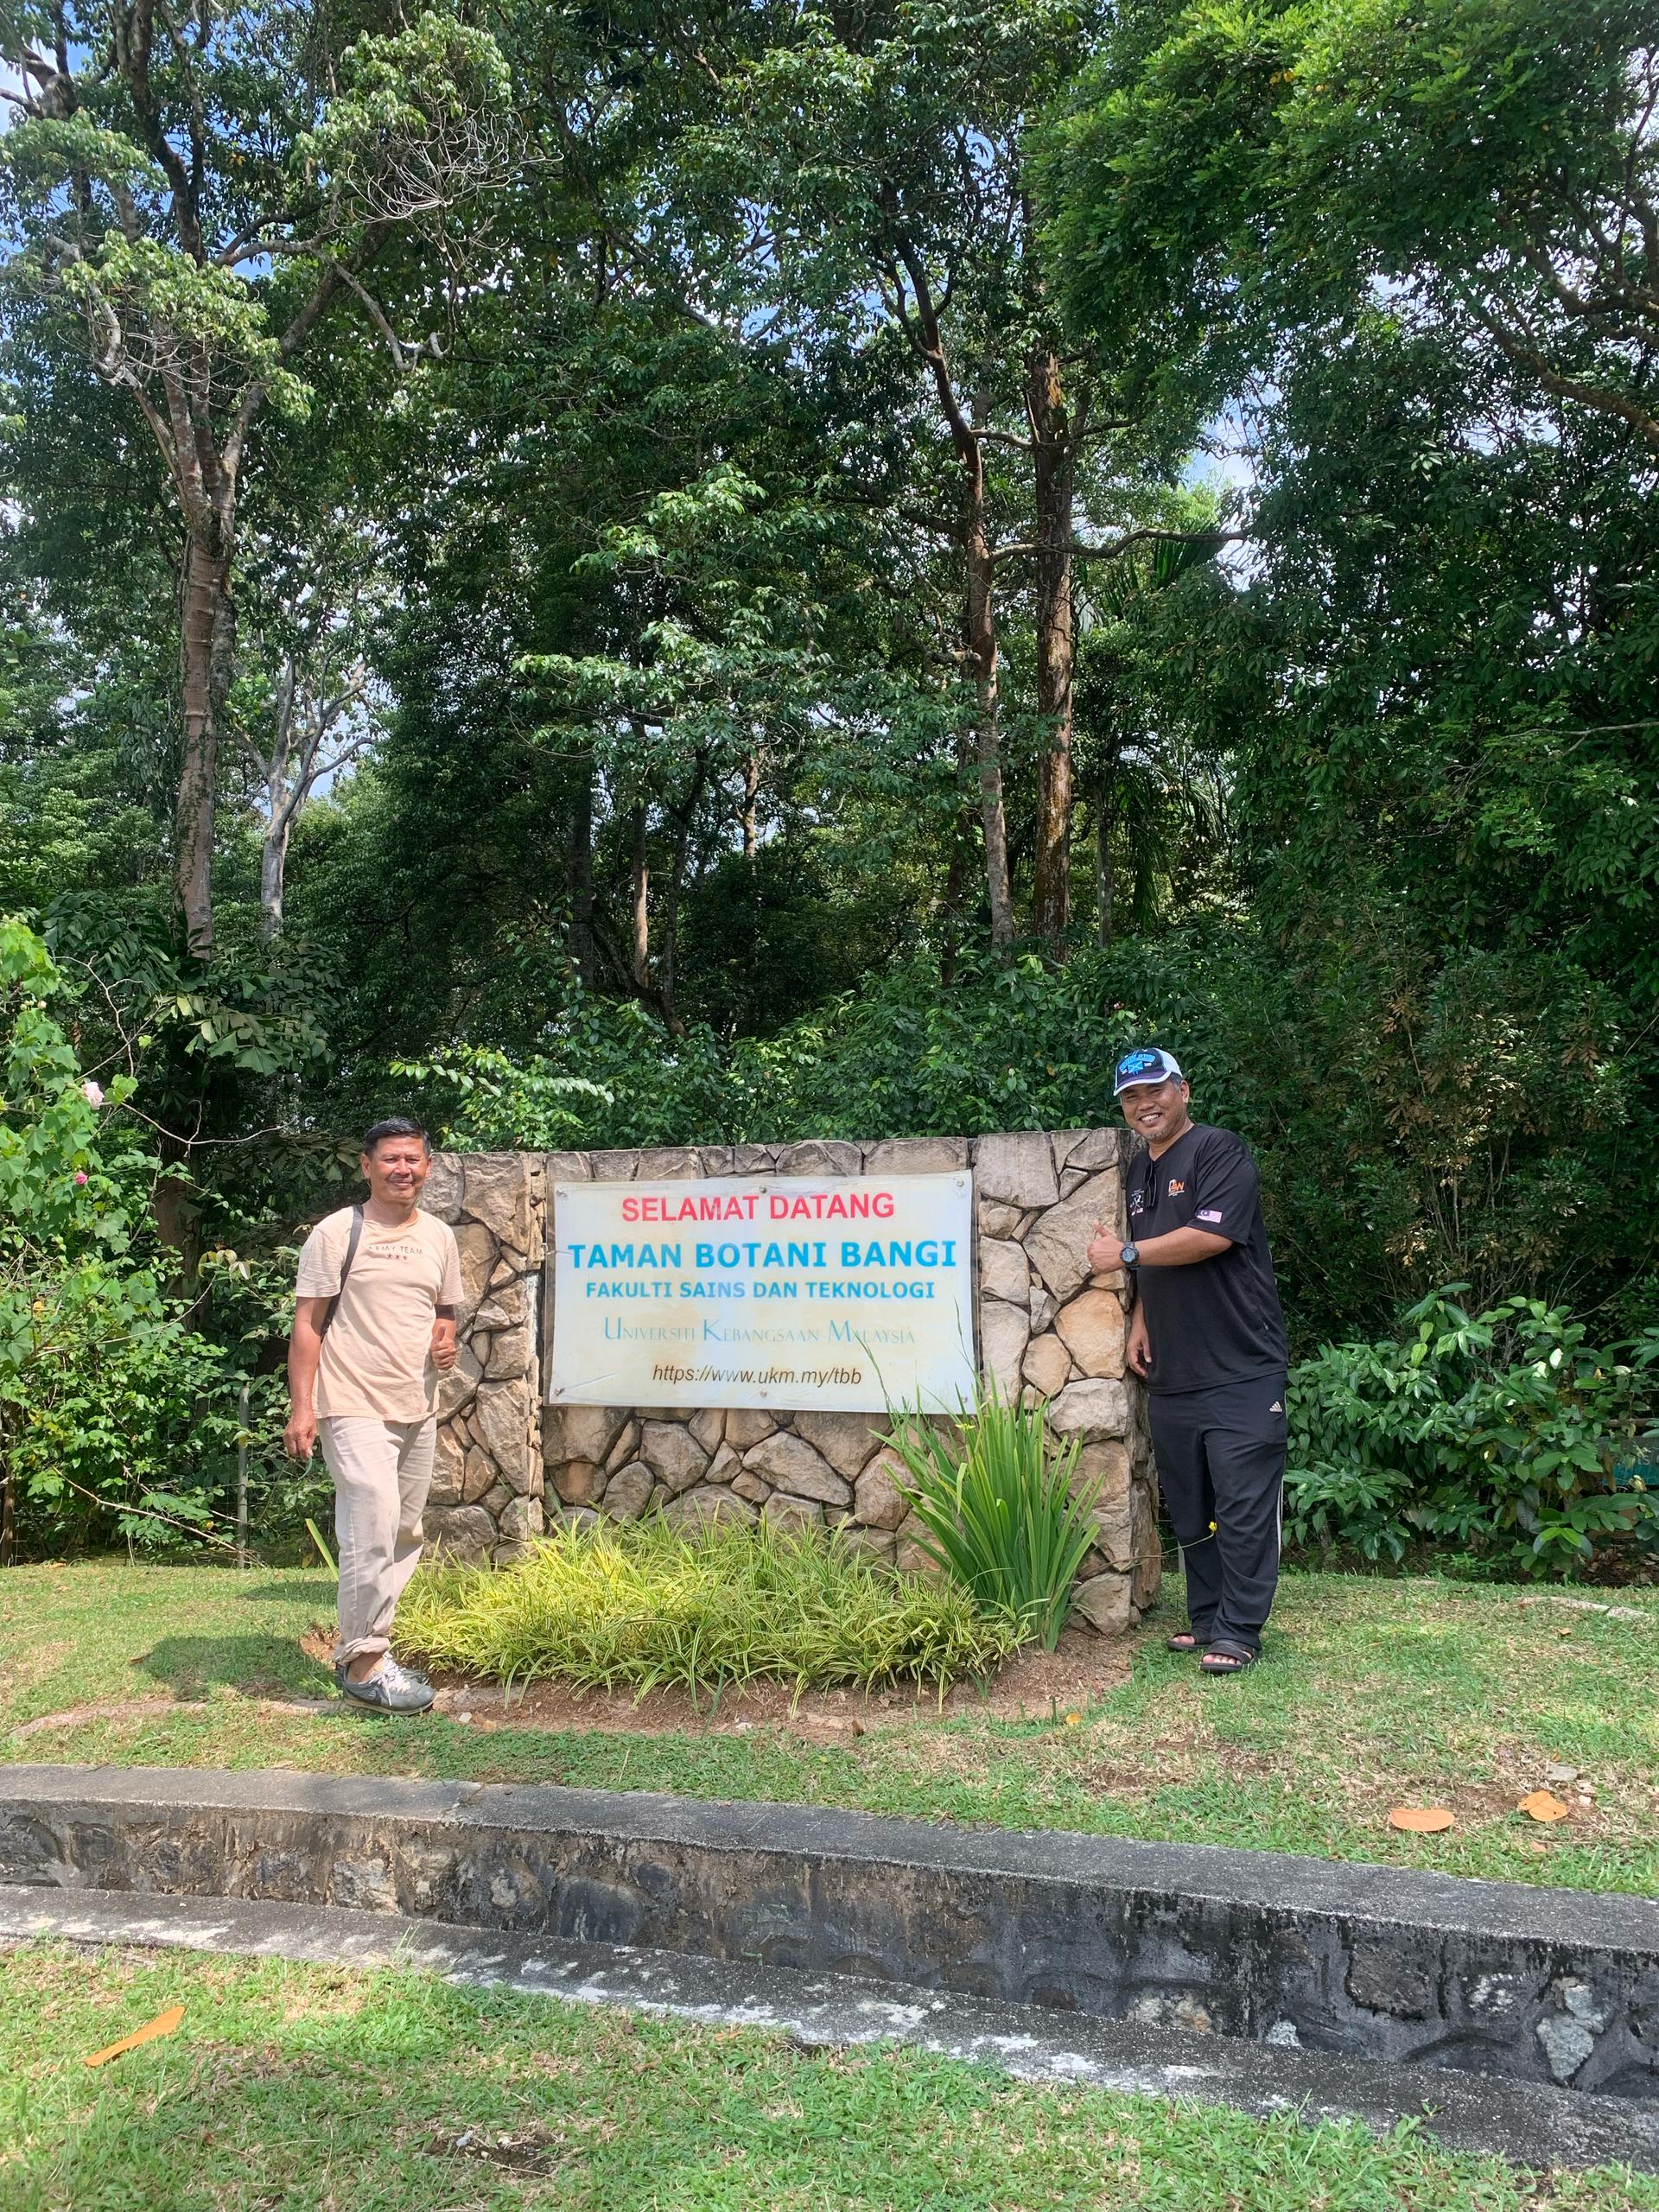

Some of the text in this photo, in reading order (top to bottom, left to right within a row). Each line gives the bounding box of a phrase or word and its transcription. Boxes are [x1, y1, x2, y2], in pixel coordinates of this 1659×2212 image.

[622, 1192, 894, 1222] SELAMAT DATANG
[568, 1240, 956, 1268] TAMAN BOTANI BANGI
[586, 1281, 935, 1299] FAKULTI SAINS DAN TEKNOLOGI
[605, 1317, 916, 1344] UNIVERSITI KEBANGSAAN MALAYSIA
[652, 1364, 861, 1388] https://www.ukm.my/tbb
